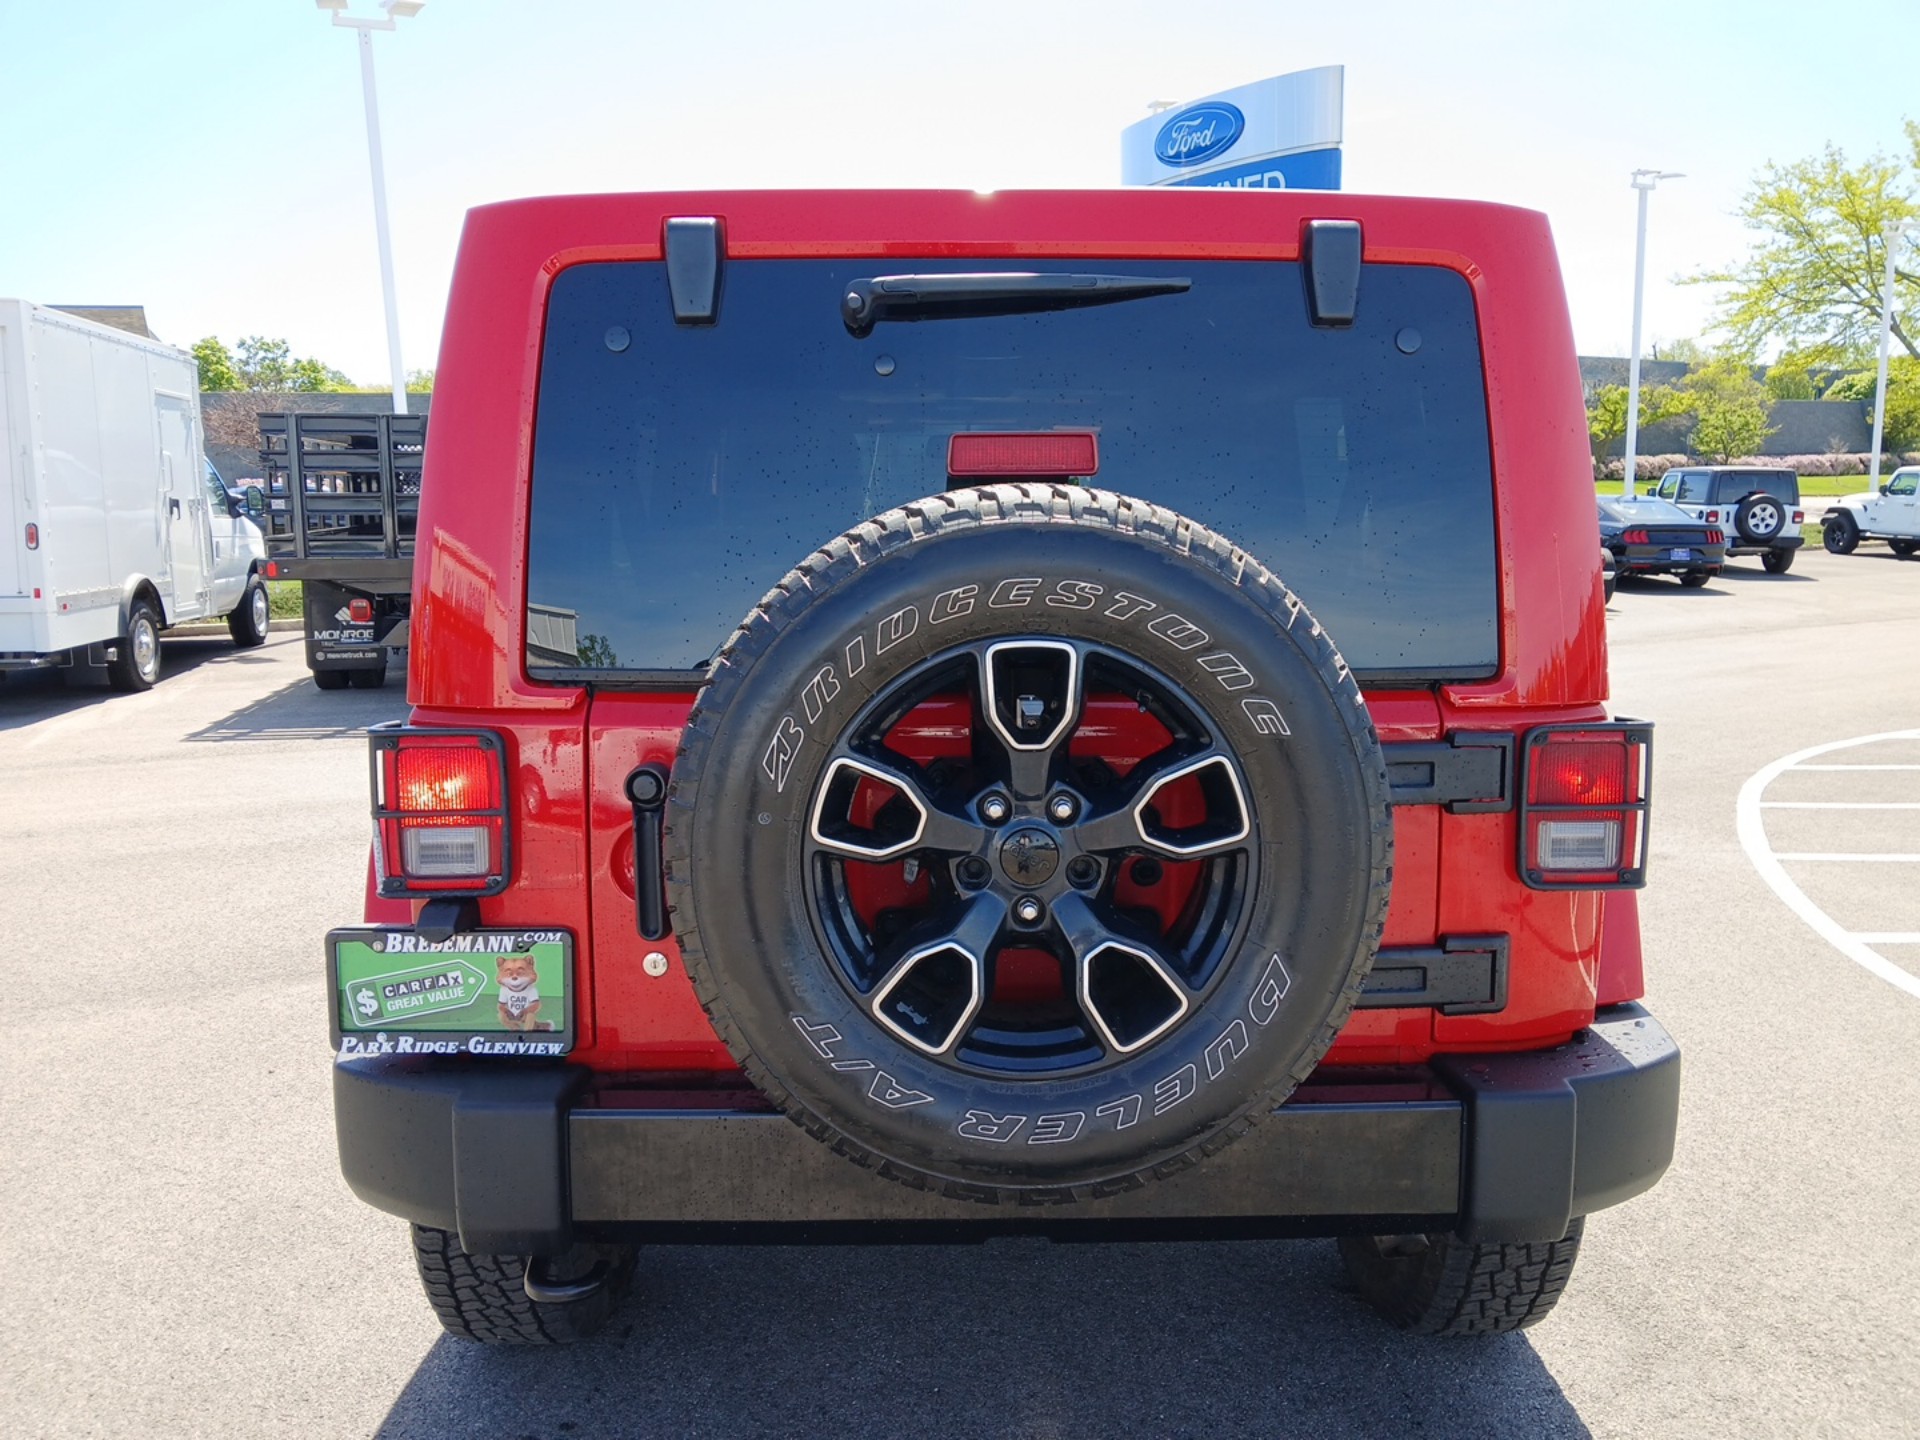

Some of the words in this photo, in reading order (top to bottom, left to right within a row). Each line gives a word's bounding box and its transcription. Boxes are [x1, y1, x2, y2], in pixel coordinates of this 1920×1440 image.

[1167, 116, 1216, 156] Ford
[762, 577, 1291, 792] BRIDGESTONE
[384, 973, 462, 997] CARFAX
[386, 995, 425, 1011] GREAT
[427, 986, 466, 1003] VALUE
[510, 995, 528, 1003] CAR
[340, 1037, 395, 1054] PARK
[791, 1012, 937, 1111] A/T
[957, 953, 1293, 1145] DUELER
